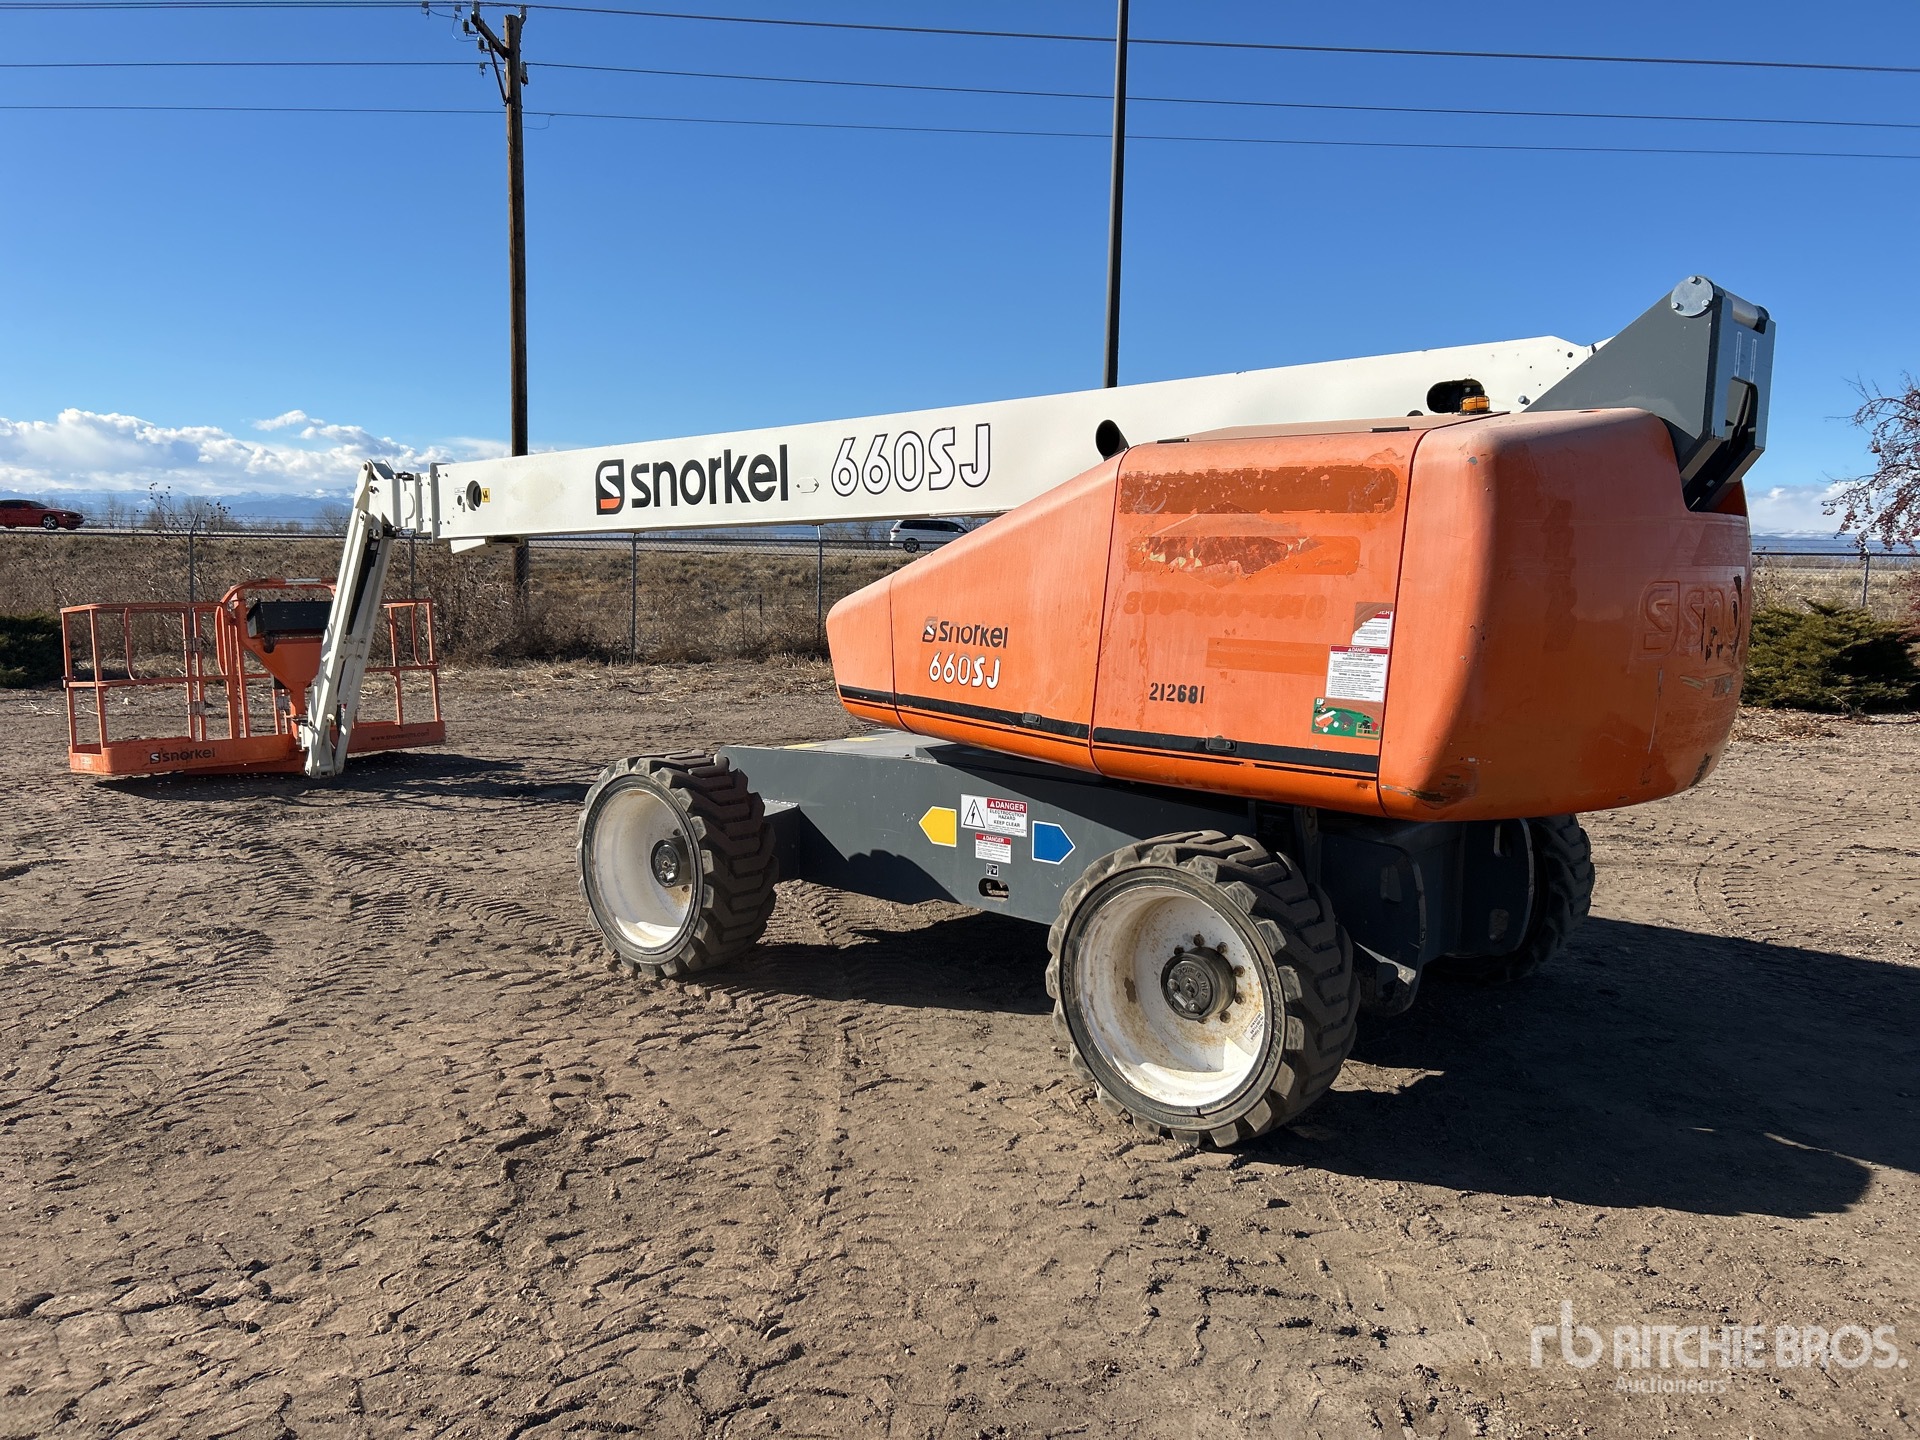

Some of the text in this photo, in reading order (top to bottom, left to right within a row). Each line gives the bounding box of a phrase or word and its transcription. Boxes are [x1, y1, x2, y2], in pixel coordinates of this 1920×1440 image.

[631, 444, 788, 509] snorkel
[831, 423, 991, 497] 660SJ
[928, 651, 1001, 689] 660SJ
[1149, 682, 1205, 704] 212681
[995, 801, 1025, 811] DANGER
